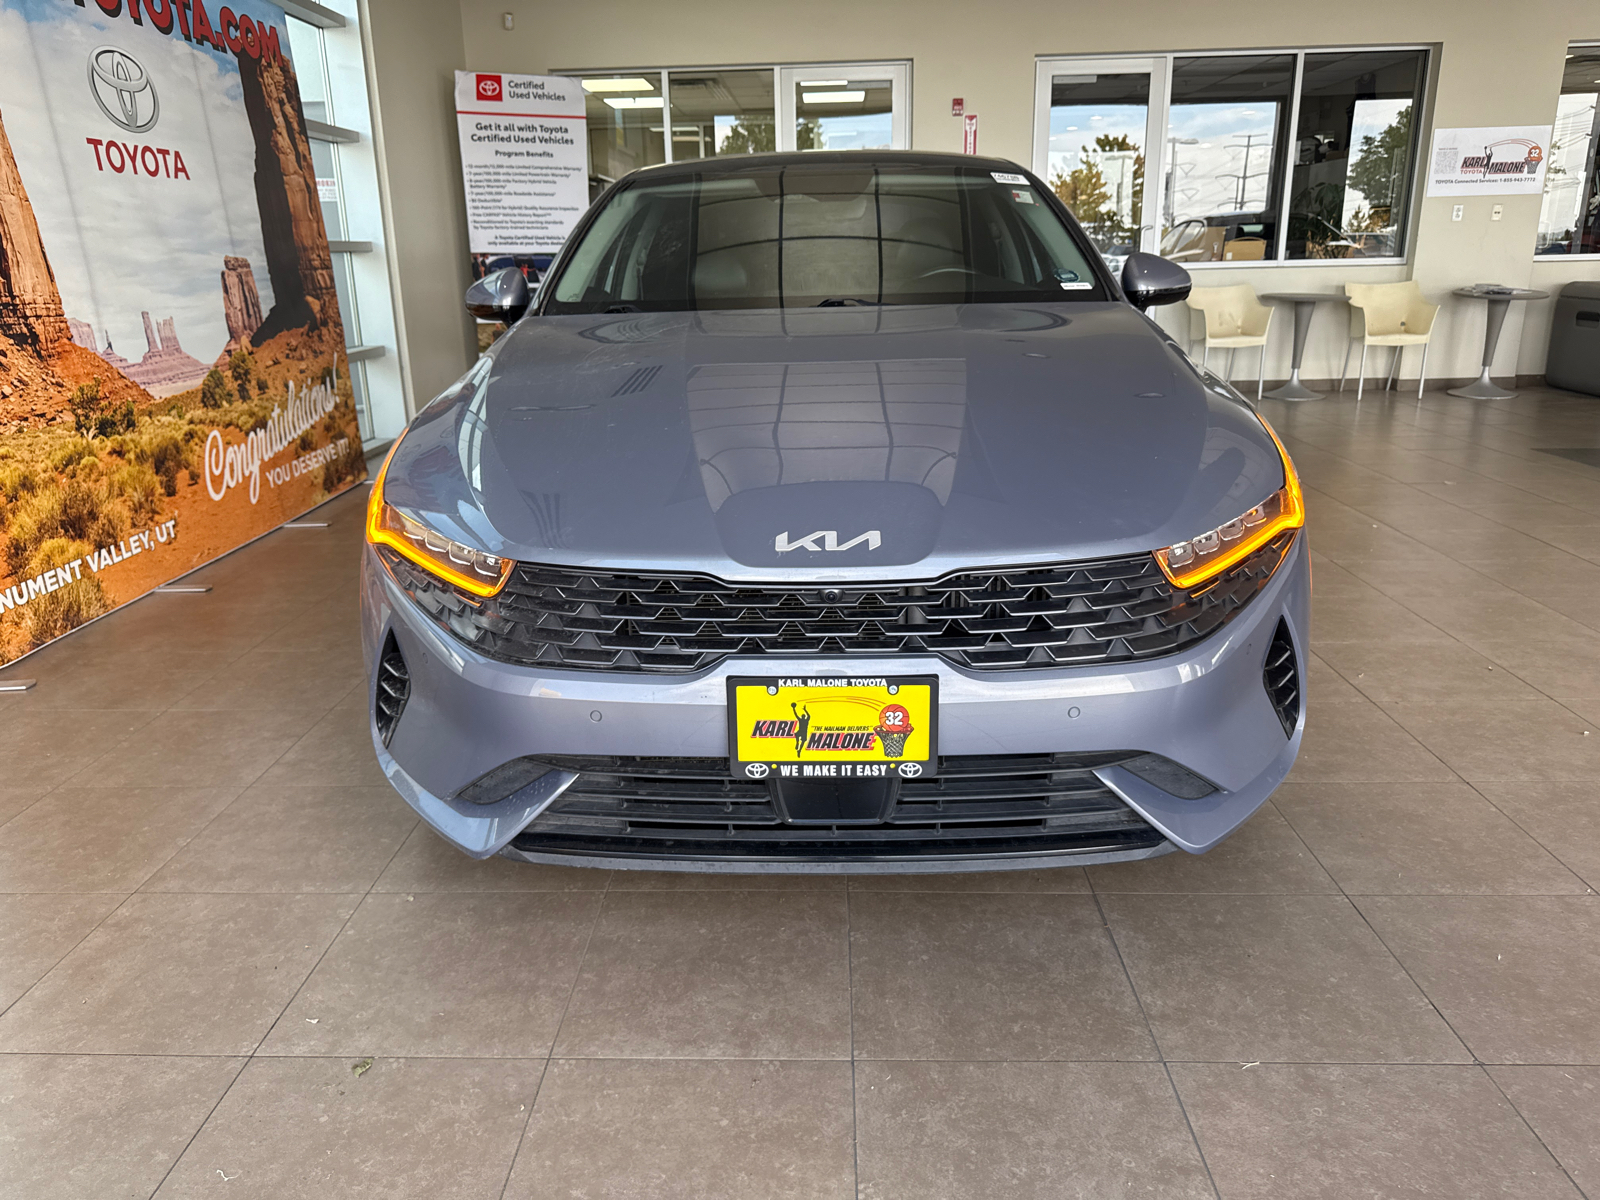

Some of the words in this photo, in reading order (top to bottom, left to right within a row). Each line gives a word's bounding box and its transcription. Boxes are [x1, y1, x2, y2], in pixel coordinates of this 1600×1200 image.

[508, 80, 544, 90] Certified
[509, 91, 530, 99] Used
[532, 92, 566, 101] Vehicles
[476, 122, 492, 131] Get
[494, 123, 502, 131] it
[503, 124, 515, 132] all
[517, 124, 537, 132] with
[540, 125, 568, 135] Toyota
[471, 134, 512, 143] Certified
[513, 135, 536, 144] Used
[538, 136, 574, 145] Vehicles
[86, 137, 190, 181] TOYOTA
[495, 150, 525, 158] Program
[1530, 150, 1539, 158] 32
[1461, 156, 1488, 169] KARL
[1488, 162, 1526, 174] MALONE
[204, 352, 340, 504] Congratulations!
[266, 466, 290, 488] YOU
[291, 444, 336, 476] DESERVE
[338, 438, 350, 458] IT!
[775, 530, 882, 552] KIA
[0, 558, 82, 614] NUMENT
[86, 532, 155, 574] VALLEY,
[156, 519, 177, 544] UT
[778, 679, 804, 687] KARL
[808, 678, 848, 687] MALONE
[851, 678, 887, 687] TOYOTA
[885, 712, 903, 726] 32
[750, 720, 798, 738] KARL
[806, 732, 876, 751] MALONE
[780, 765, 798, 776] WE
[804, 765, 836, 776] MAKE
[842, 765, 851, 776] IT
[856, 764, 887, 776] EASY
